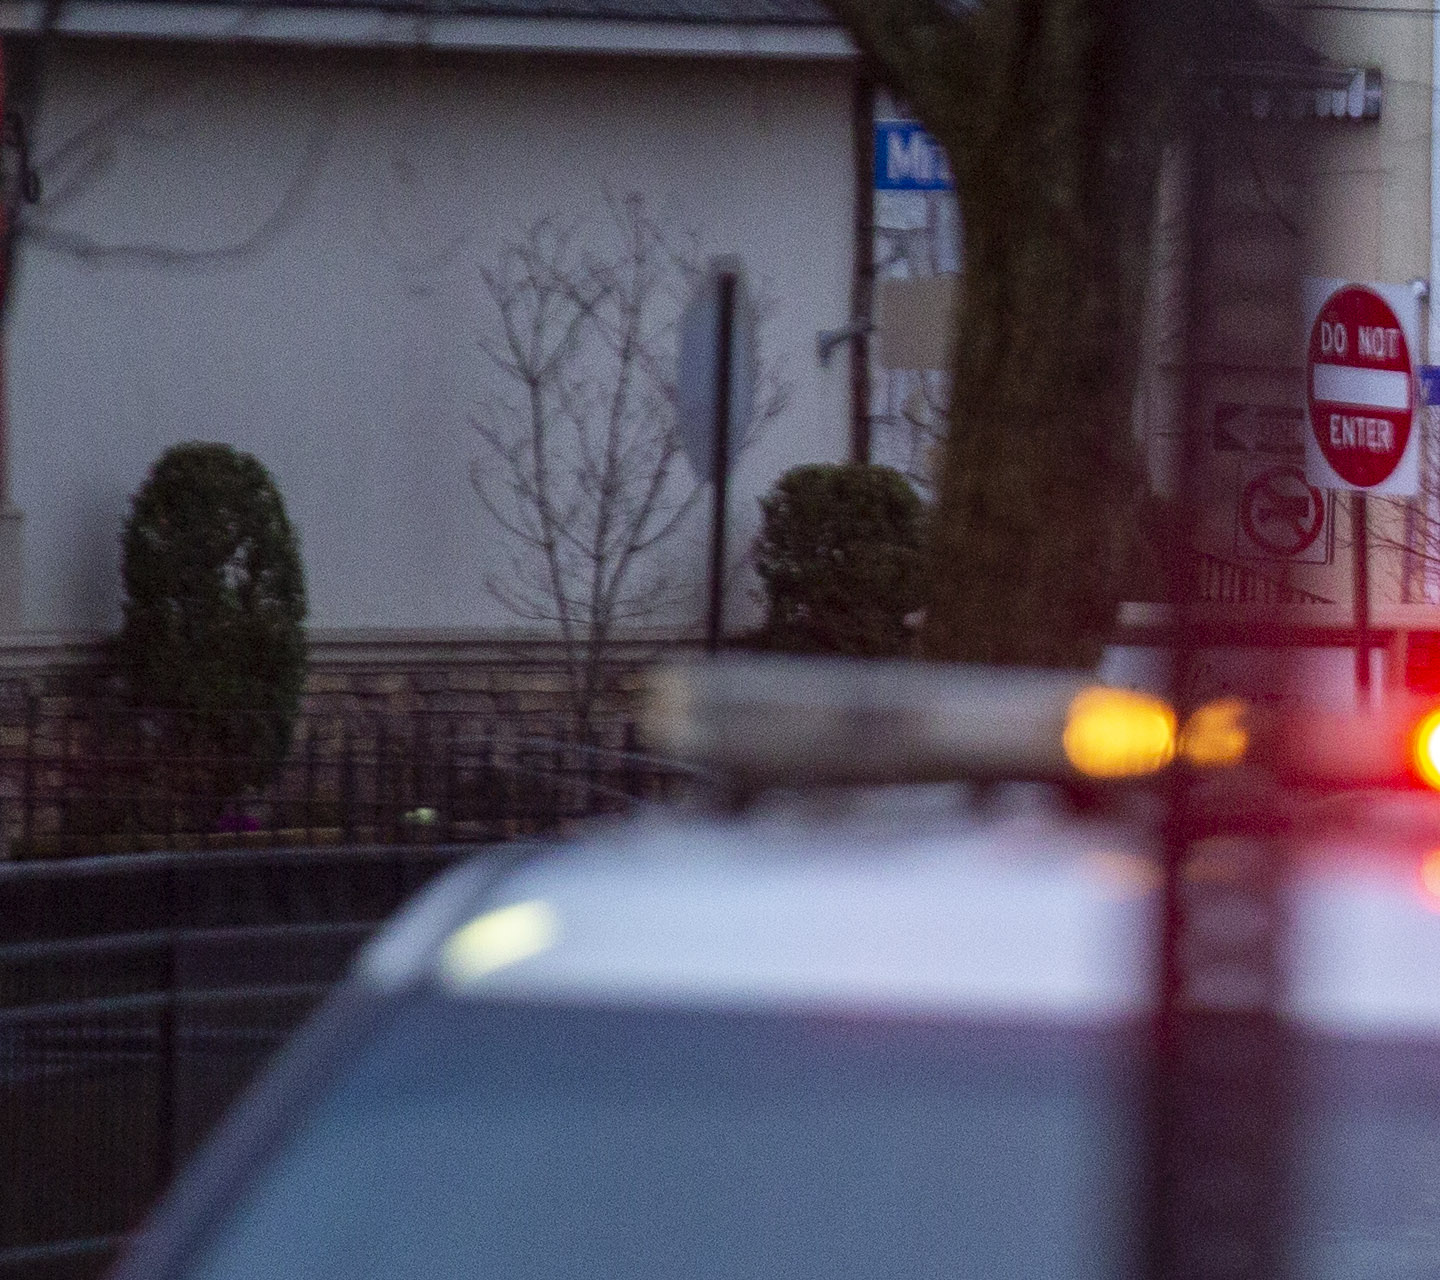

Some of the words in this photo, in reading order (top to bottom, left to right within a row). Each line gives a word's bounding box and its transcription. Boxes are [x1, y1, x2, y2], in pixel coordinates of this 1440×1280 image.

[1320, 320, 1348, 355] DO
[1358, 325, 1401, 360] NOT
[1329, 413, 1395, 453] ENTER
